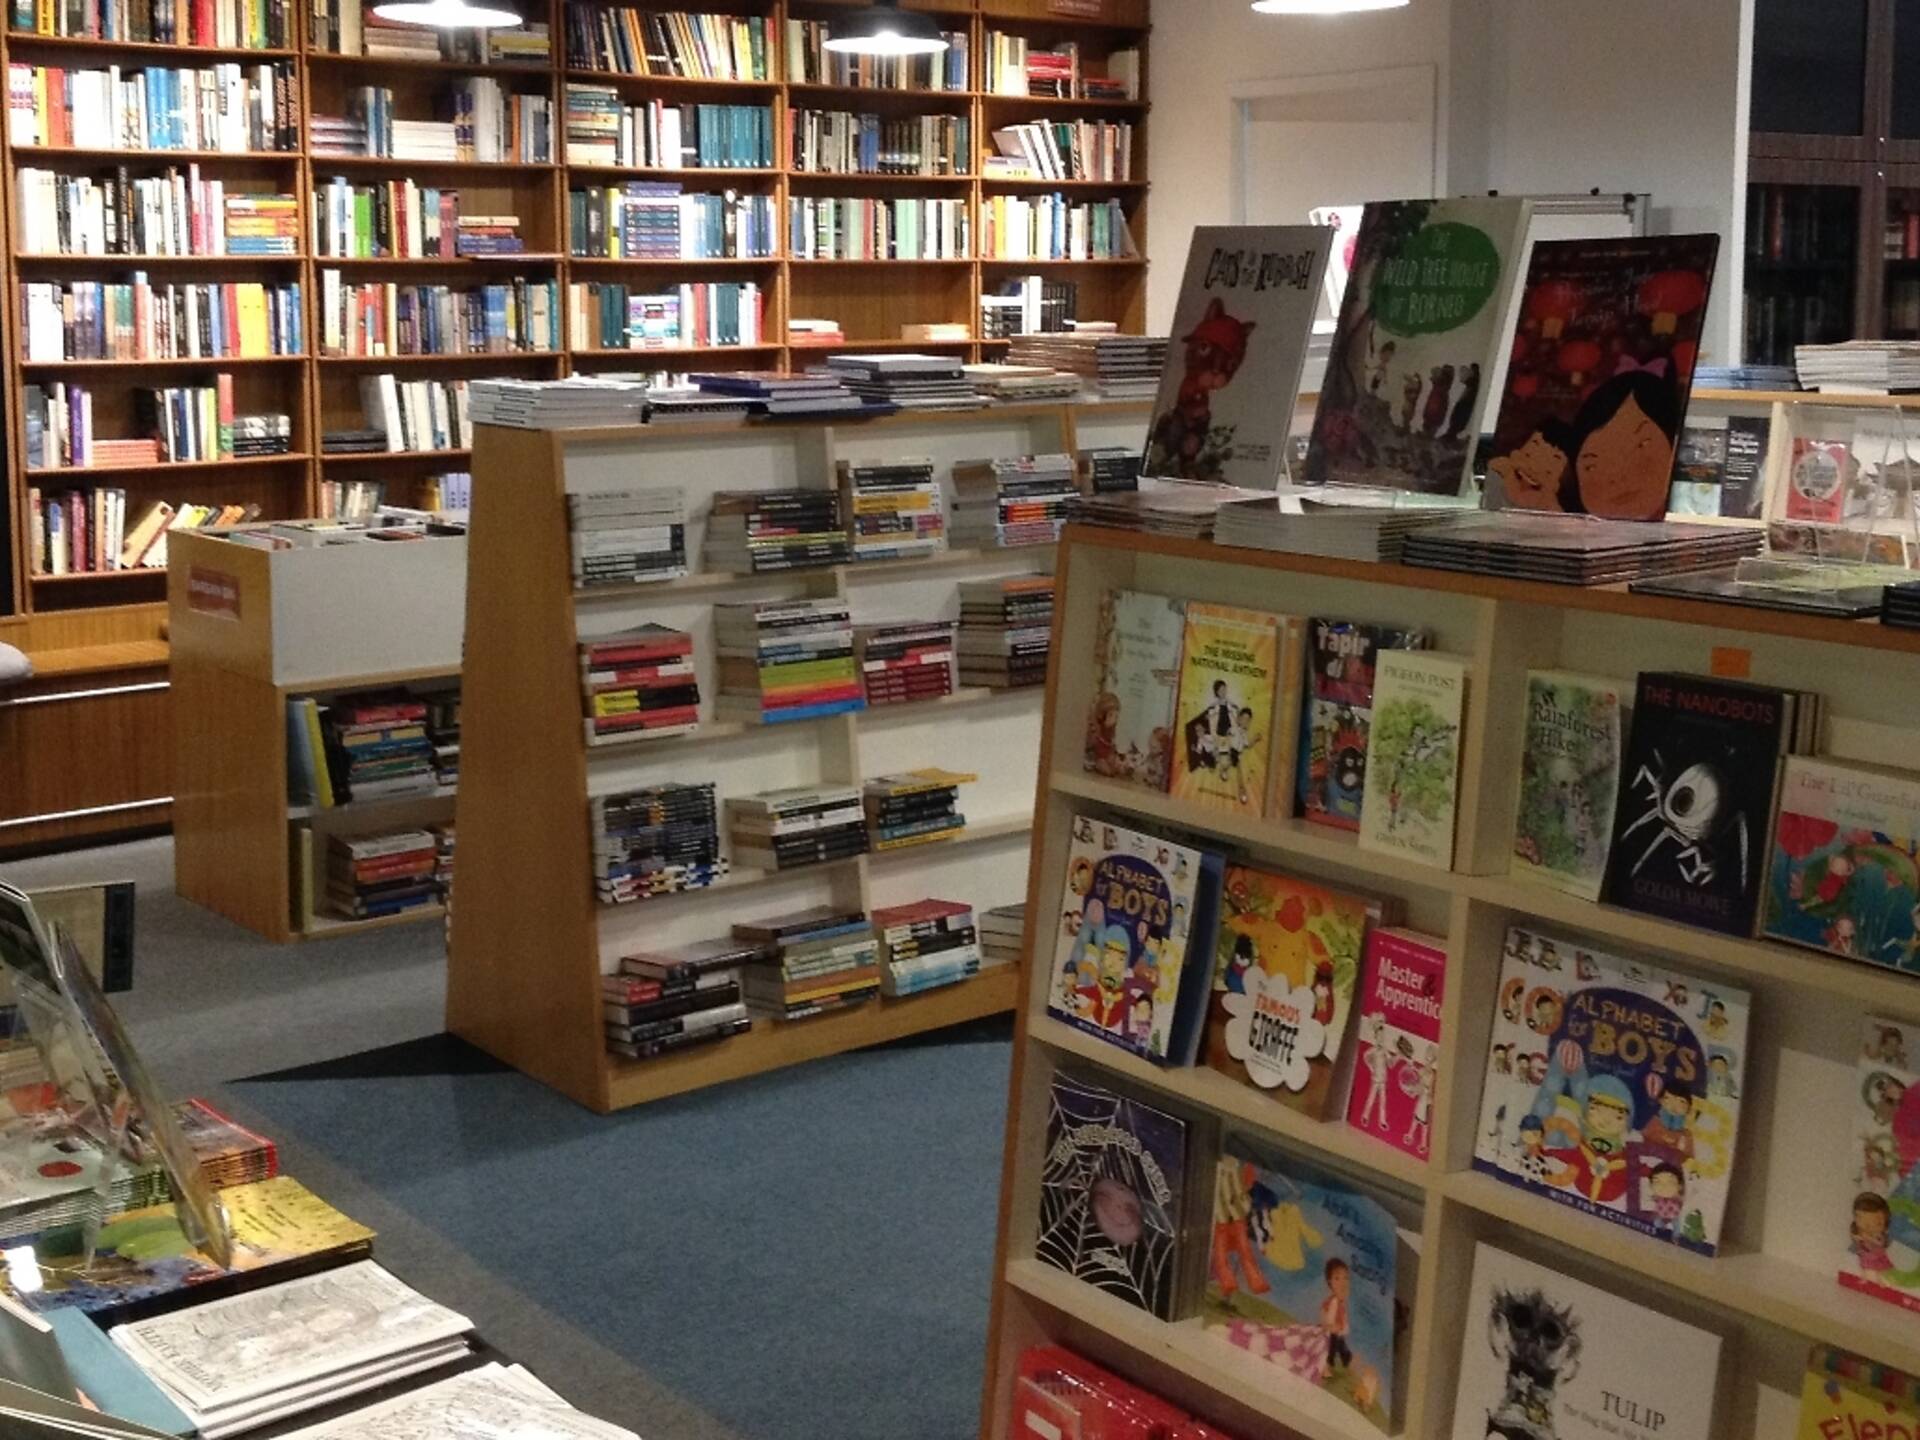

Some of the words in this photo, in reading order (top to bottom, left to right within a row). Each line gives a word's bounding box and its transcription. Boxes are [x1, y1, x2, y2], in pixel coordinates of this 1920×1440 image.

[1407, 291, 1465, 325] BORNEO
[1535, 702, 1612, 743] Rainforest
[1644, 685, 1672, 707] THE
[1678, 690, 1776, 725] NANOBOTS
[1540, 727, 1575, 753] Hike
[1099, 861, 1164, 894] ALPHABET
[1107, 880, 1169, 926] BOYS
[1378, 956, 1425, 990] Master
[1255, 992, 1301, 1025] FAMOUS
[1573, 994, 1686, 1041] ALPHABET
[1249, 1010, 1299, 1065] GIRAFFE
[1588, 1019, 1698, 1082] BOYS
[1601, 1390, 1666, 1431] TULIP
